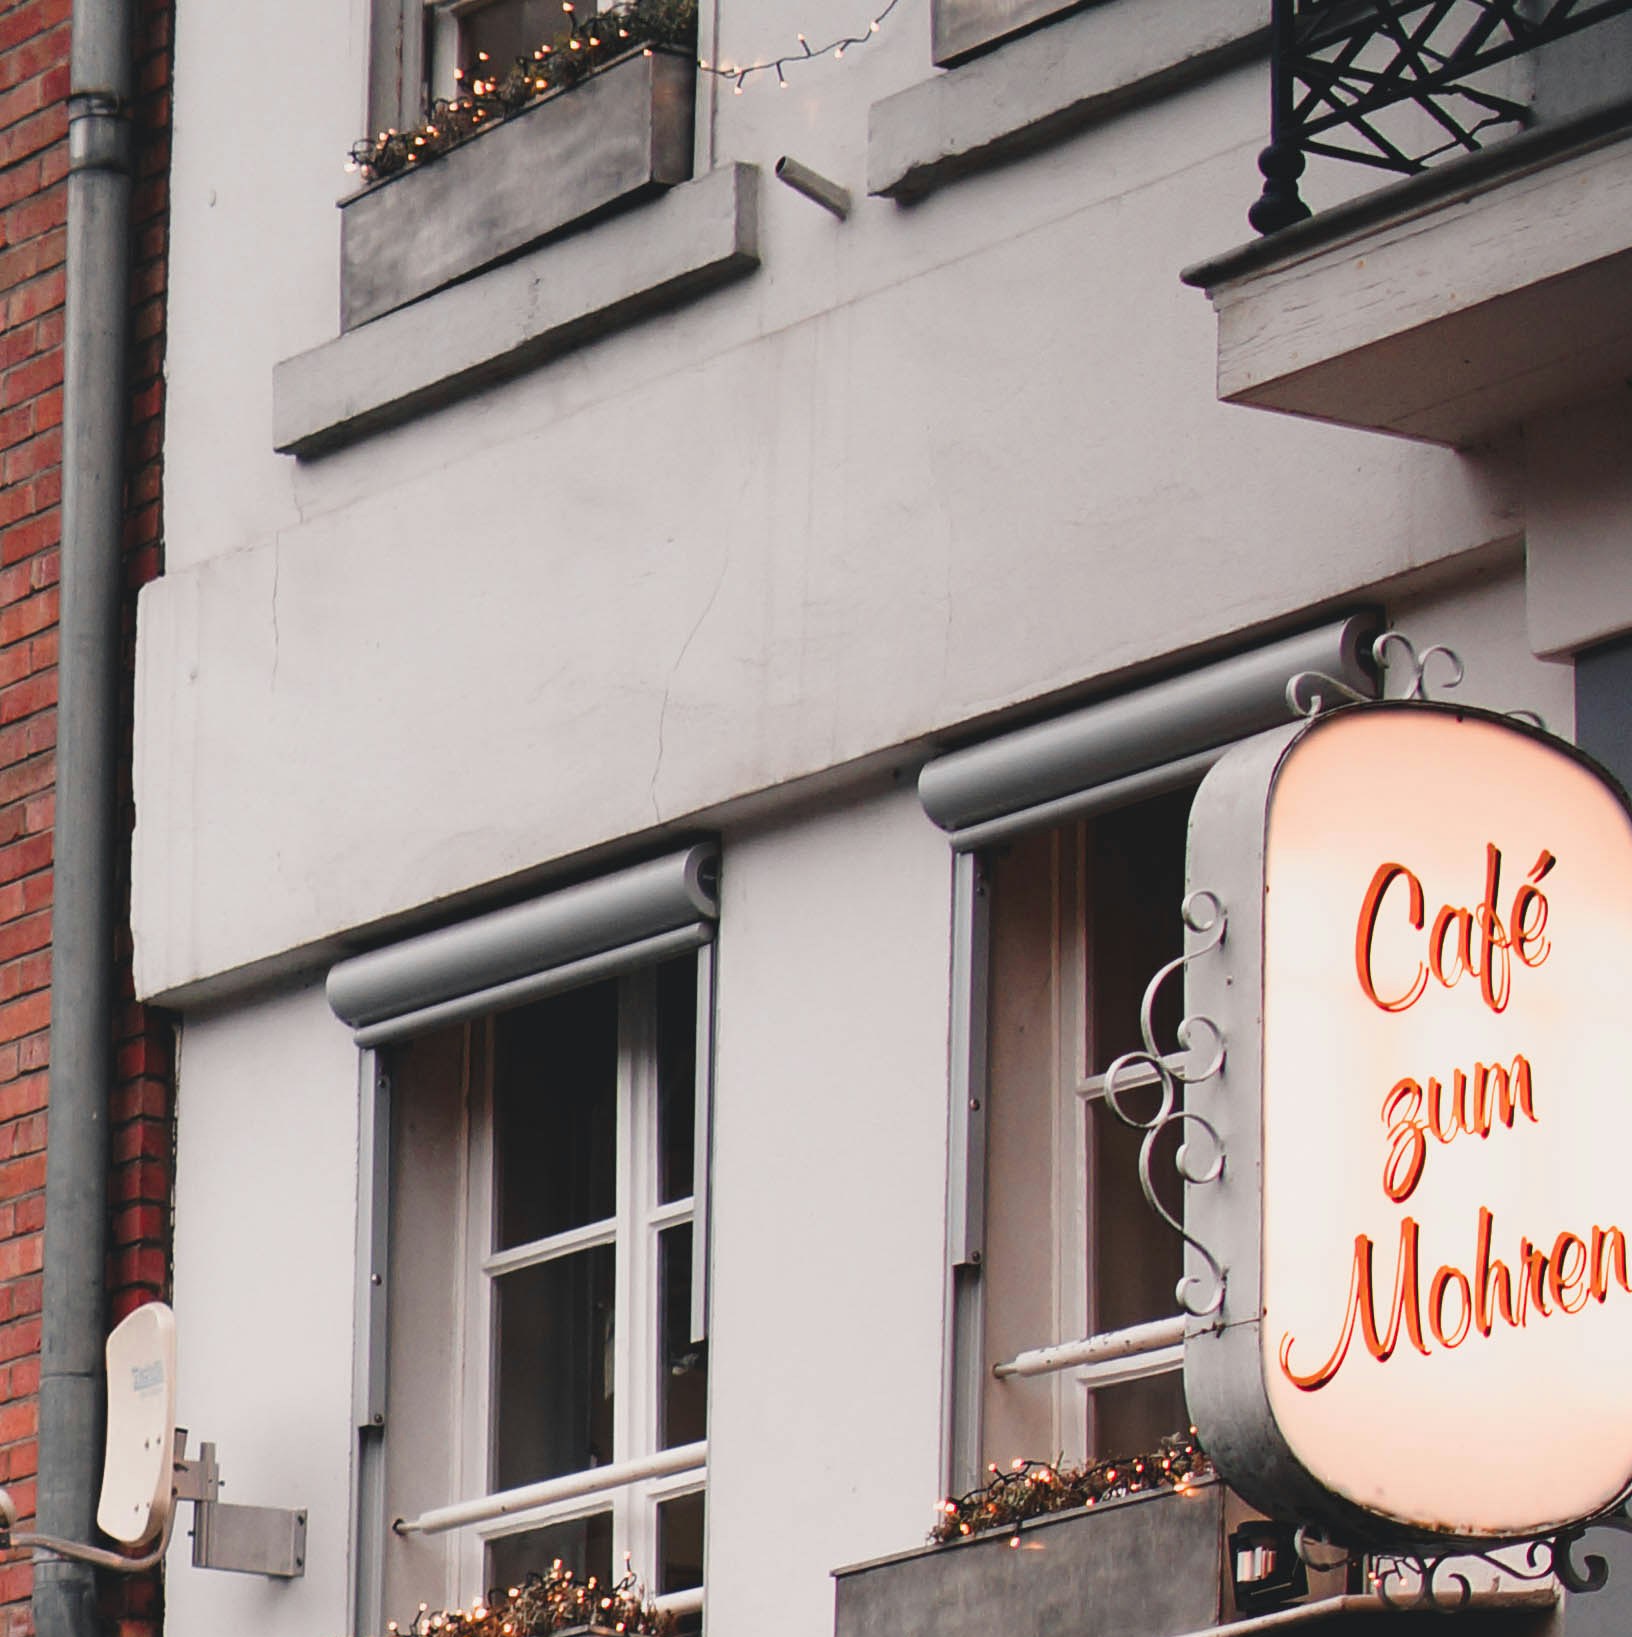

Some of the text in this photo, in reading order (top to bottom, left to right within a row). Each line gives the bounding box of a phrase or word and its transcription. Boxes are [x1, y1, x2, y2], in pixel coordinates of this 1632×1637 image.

[1354, 843, 1557, 1014] Café
[1381, 1054, 1539, 1203] zum
[1279, 1206, 1632, 1392] Mohren
